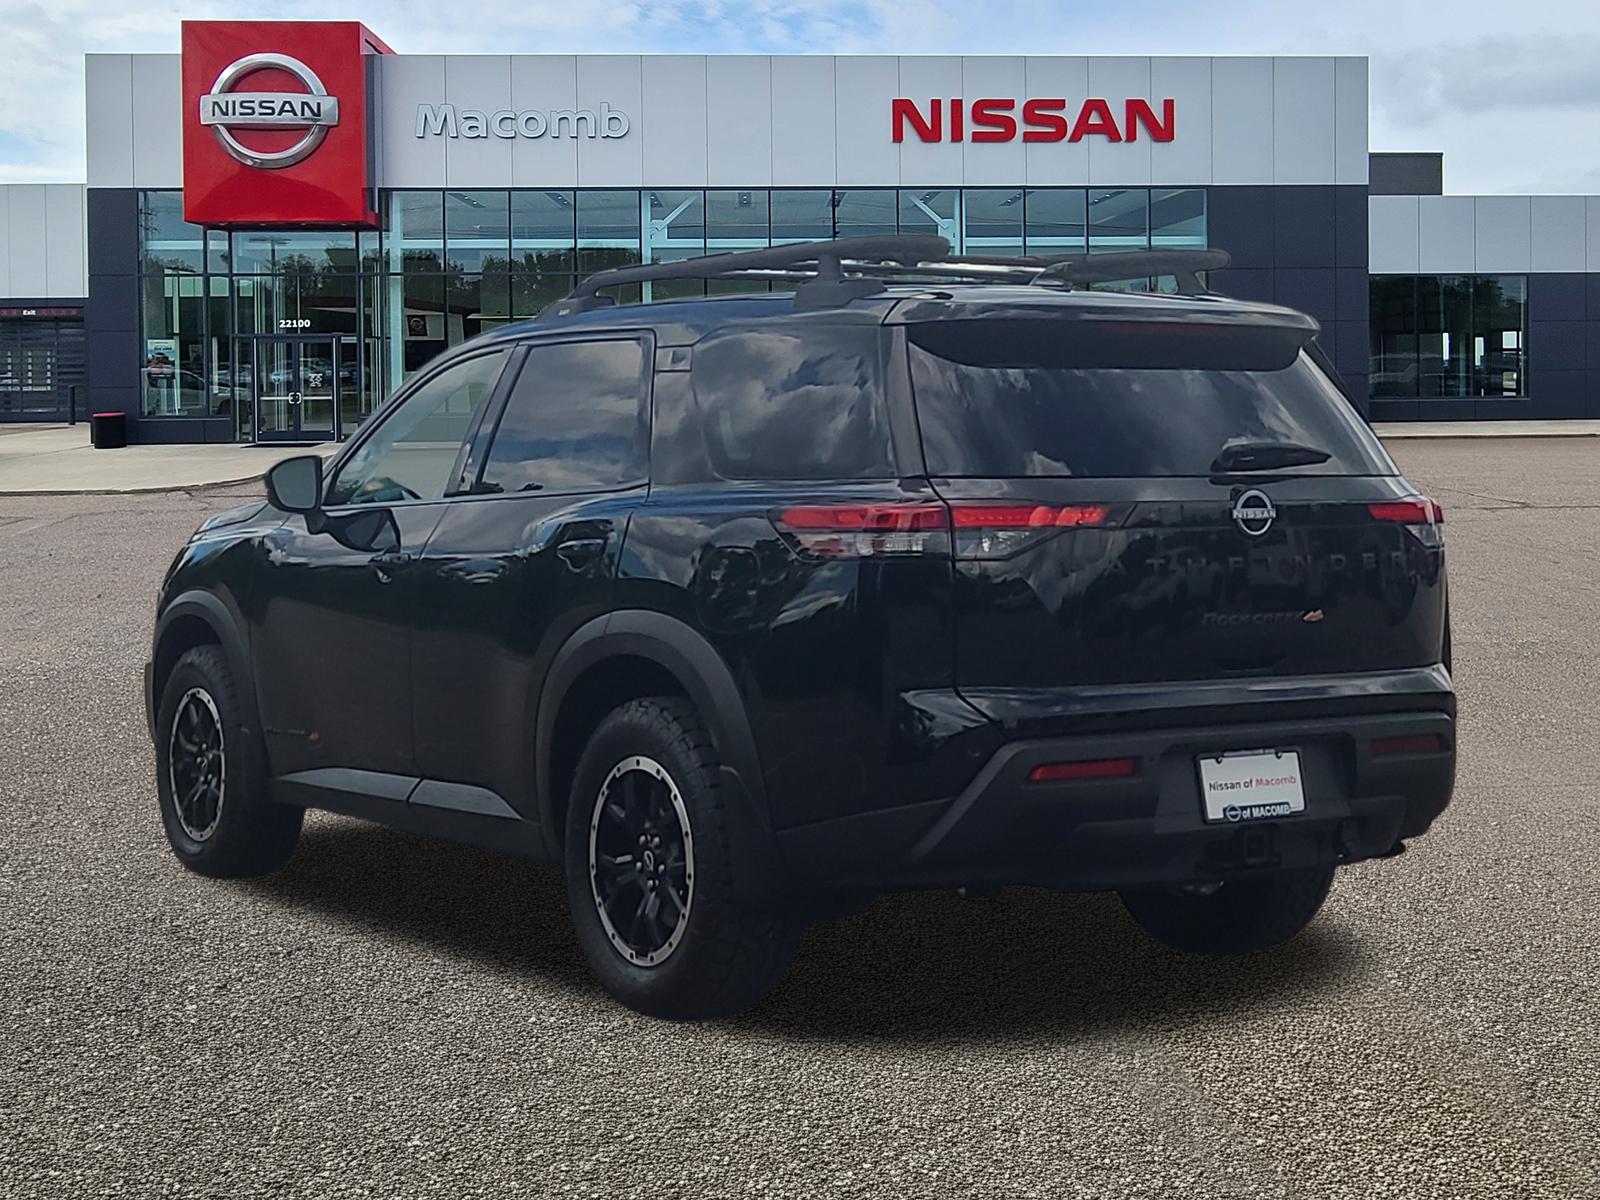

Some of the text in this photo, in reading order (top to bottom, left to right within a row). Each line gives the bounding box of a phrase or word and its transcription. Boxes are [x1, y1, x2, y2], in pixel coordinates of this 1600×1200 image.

[212, 100, 322, 118] NISSAN
[416, 102, 630, 138] Macomb
[891, 98, 1176, 142] NISSAN
[279, 319, 311, 328] 22100
[1233, 508, 1276, 519] NISSAN
[1208, 775, 1297, 793] Nissan of Macomb
[1241, 804, 1291, 819] of MACOMB
